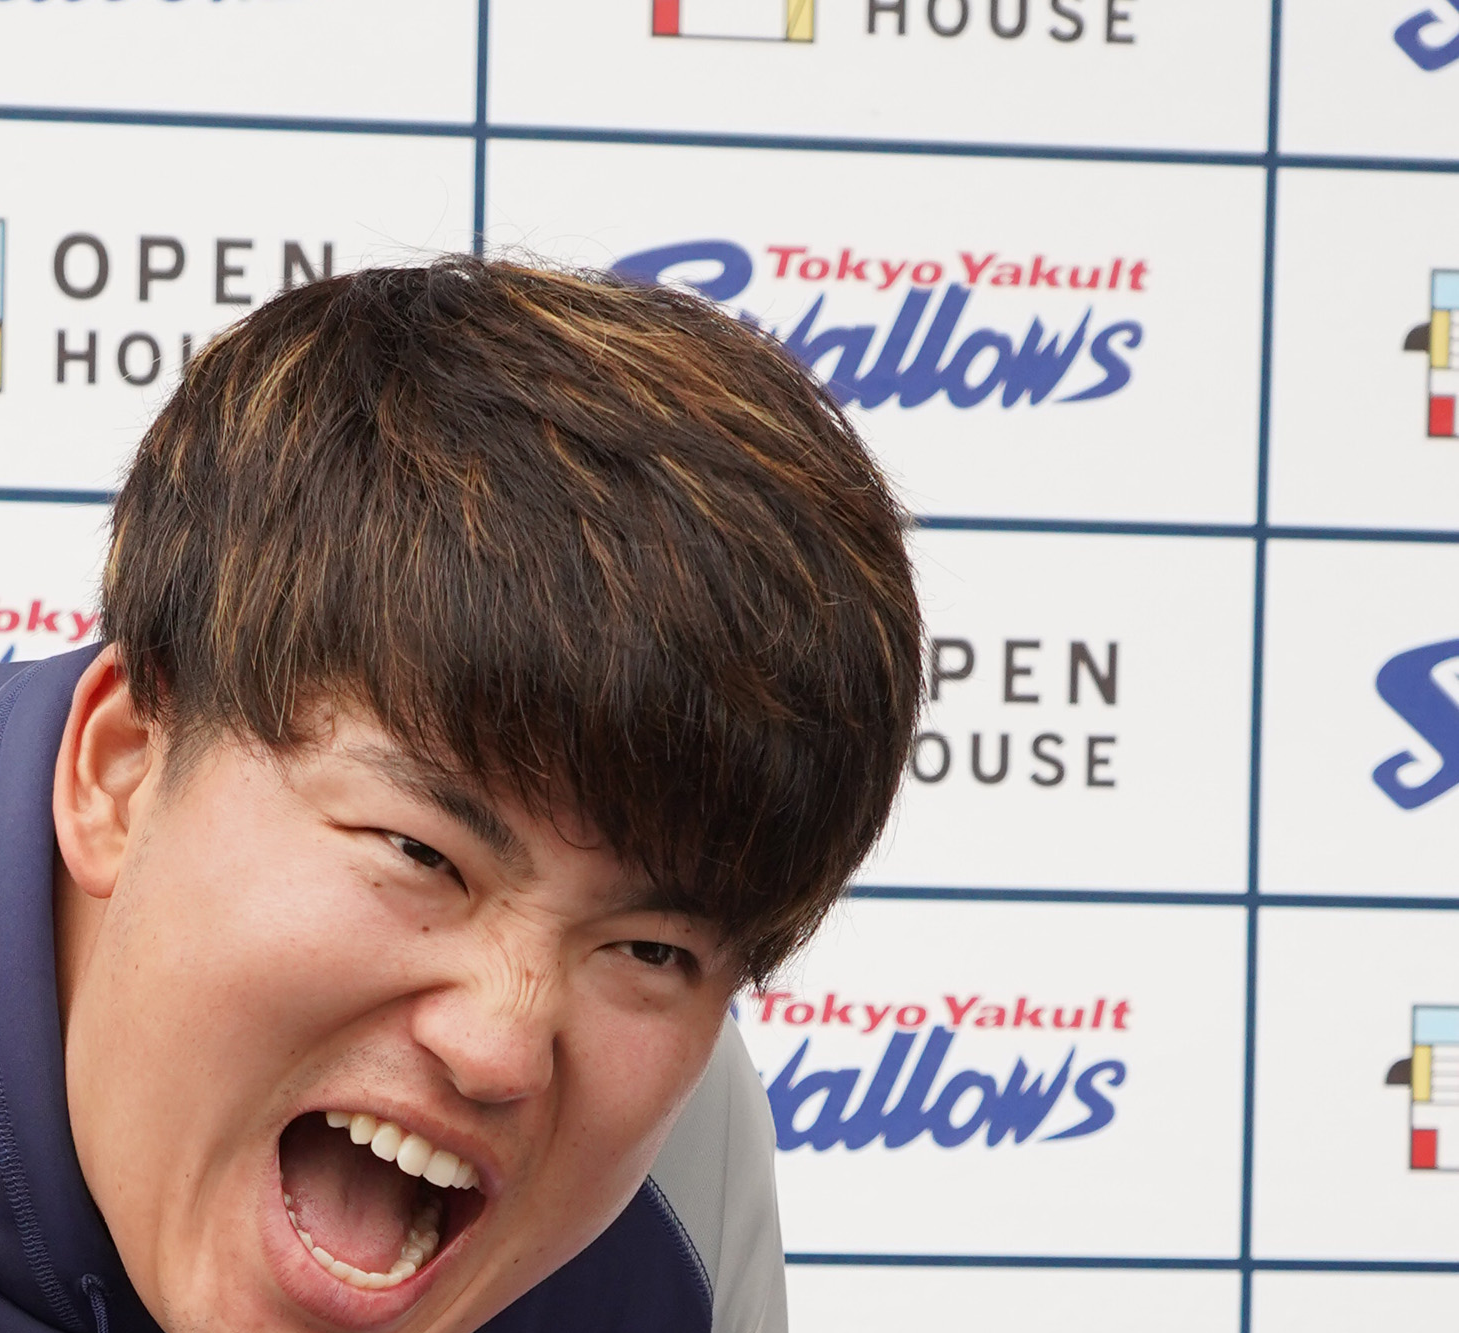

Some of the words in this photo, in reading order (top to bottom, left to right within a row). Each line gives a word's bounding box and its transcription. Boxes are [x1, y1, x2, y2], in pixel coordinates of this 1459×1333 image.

[767, 245, 943, 292] Tokyo
[960, 251, 1150, 293] Yakult
[753, 988, 929, 1034] Tokyo
[944, 995, 1132, 1032] Yakult
